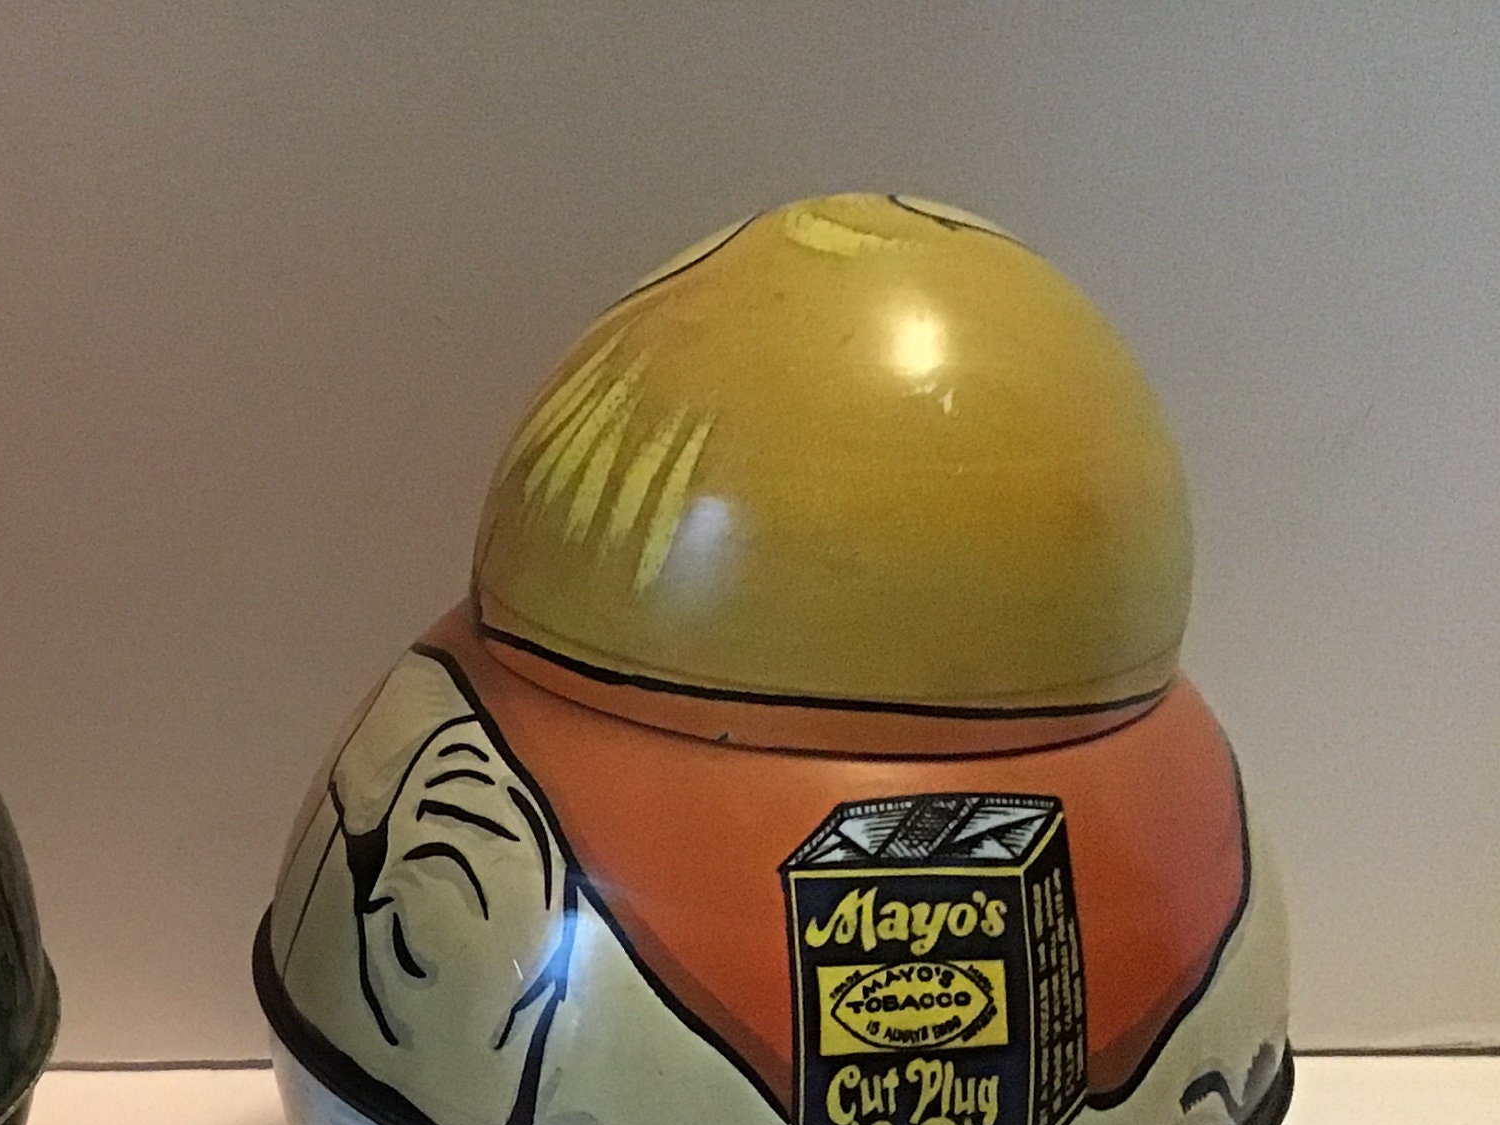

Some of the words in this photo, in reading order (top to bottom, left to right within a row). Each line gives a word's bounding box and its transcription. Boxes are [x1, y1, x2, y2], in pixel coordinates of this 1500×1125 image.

[805, 887, 1008, 956] Mayo's
[862, 966, 956, 999] MAYO'S
[846, 991, 971, 1014] TOBACCO
